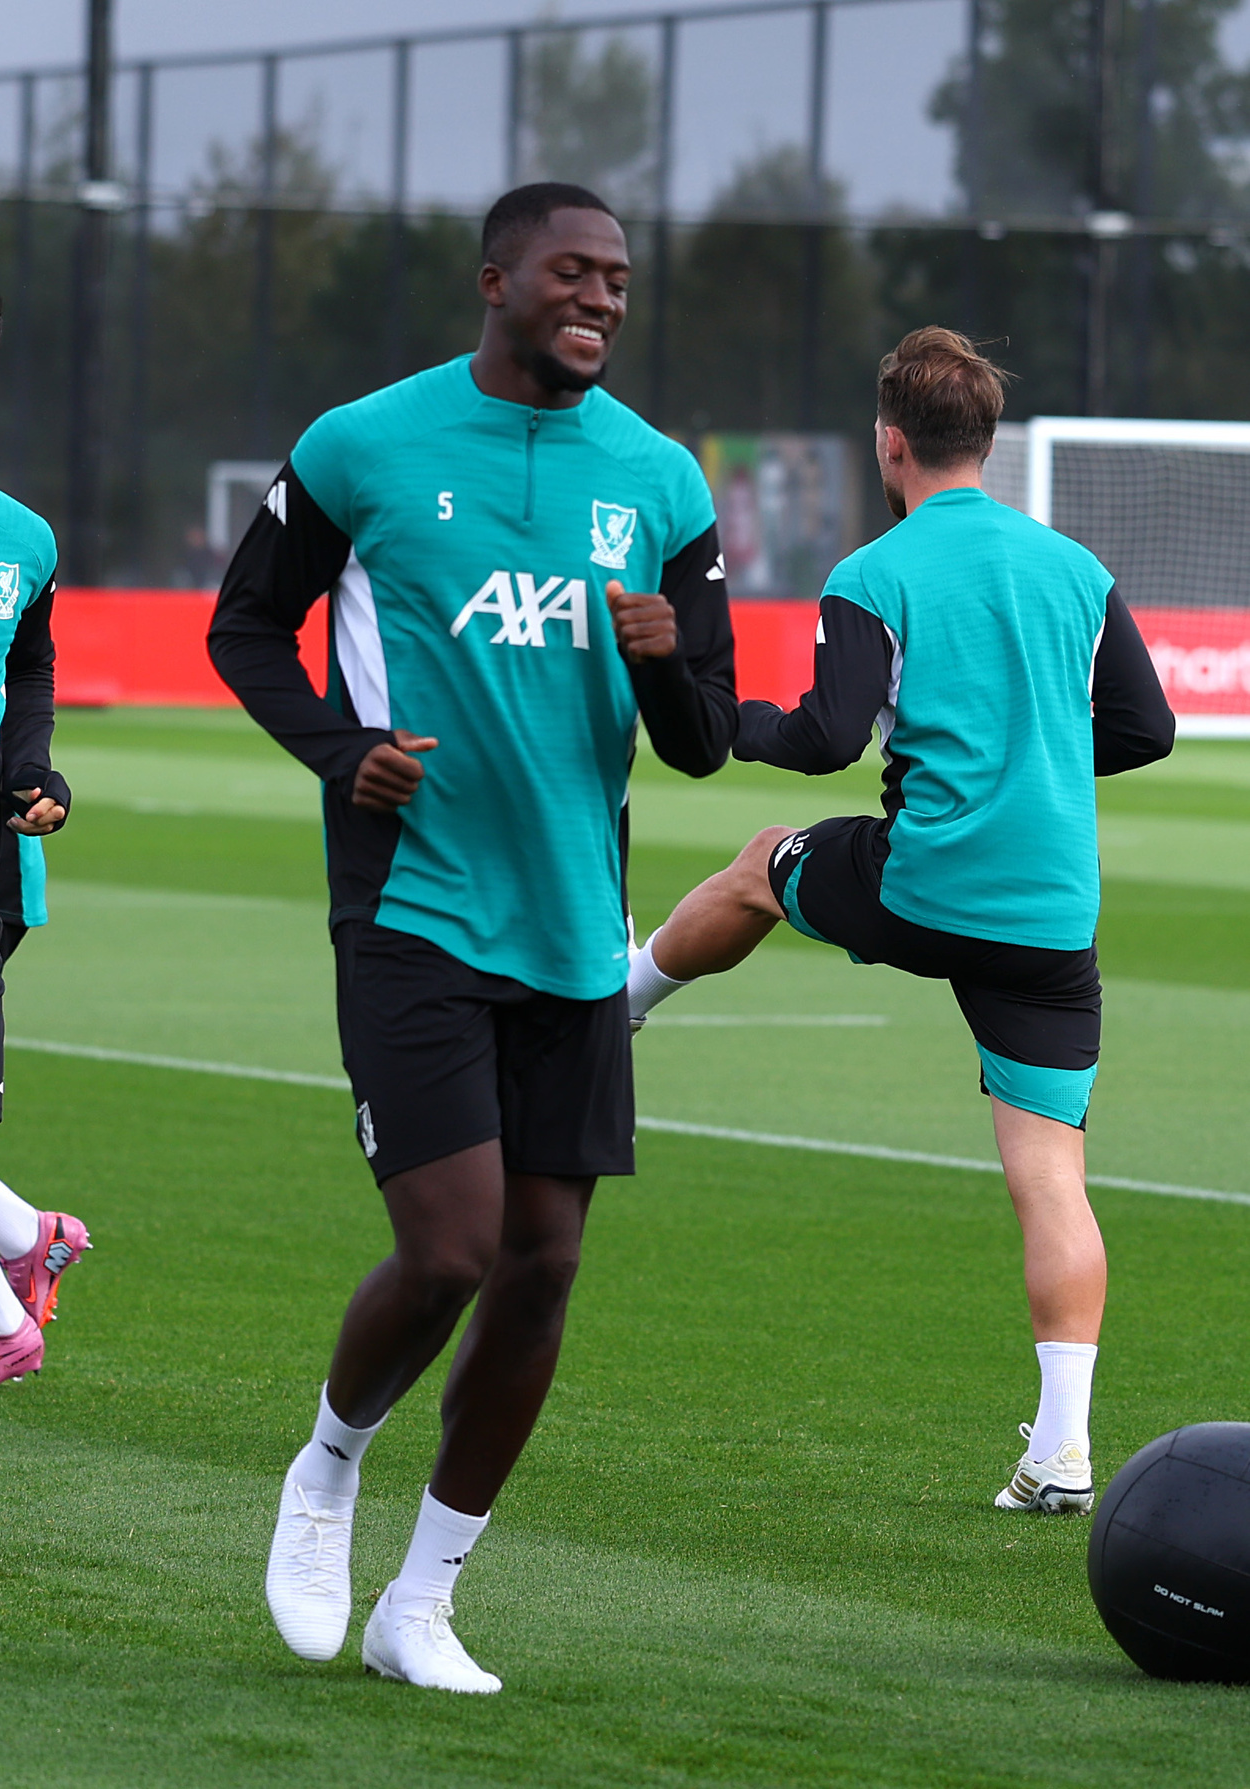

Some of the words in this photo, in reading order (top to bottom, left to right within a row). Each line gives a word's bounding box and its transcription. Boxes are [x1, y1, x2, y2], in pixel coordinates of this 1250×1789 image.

[449, 569, 590, 650] AXA
[791, 833, 810, 855] 10
[1153, 1584, 1169, 1597] DO
[1169, 1592, 1192, 1606] NOT
[1193, 1602, 1224, 1618] SLAM
